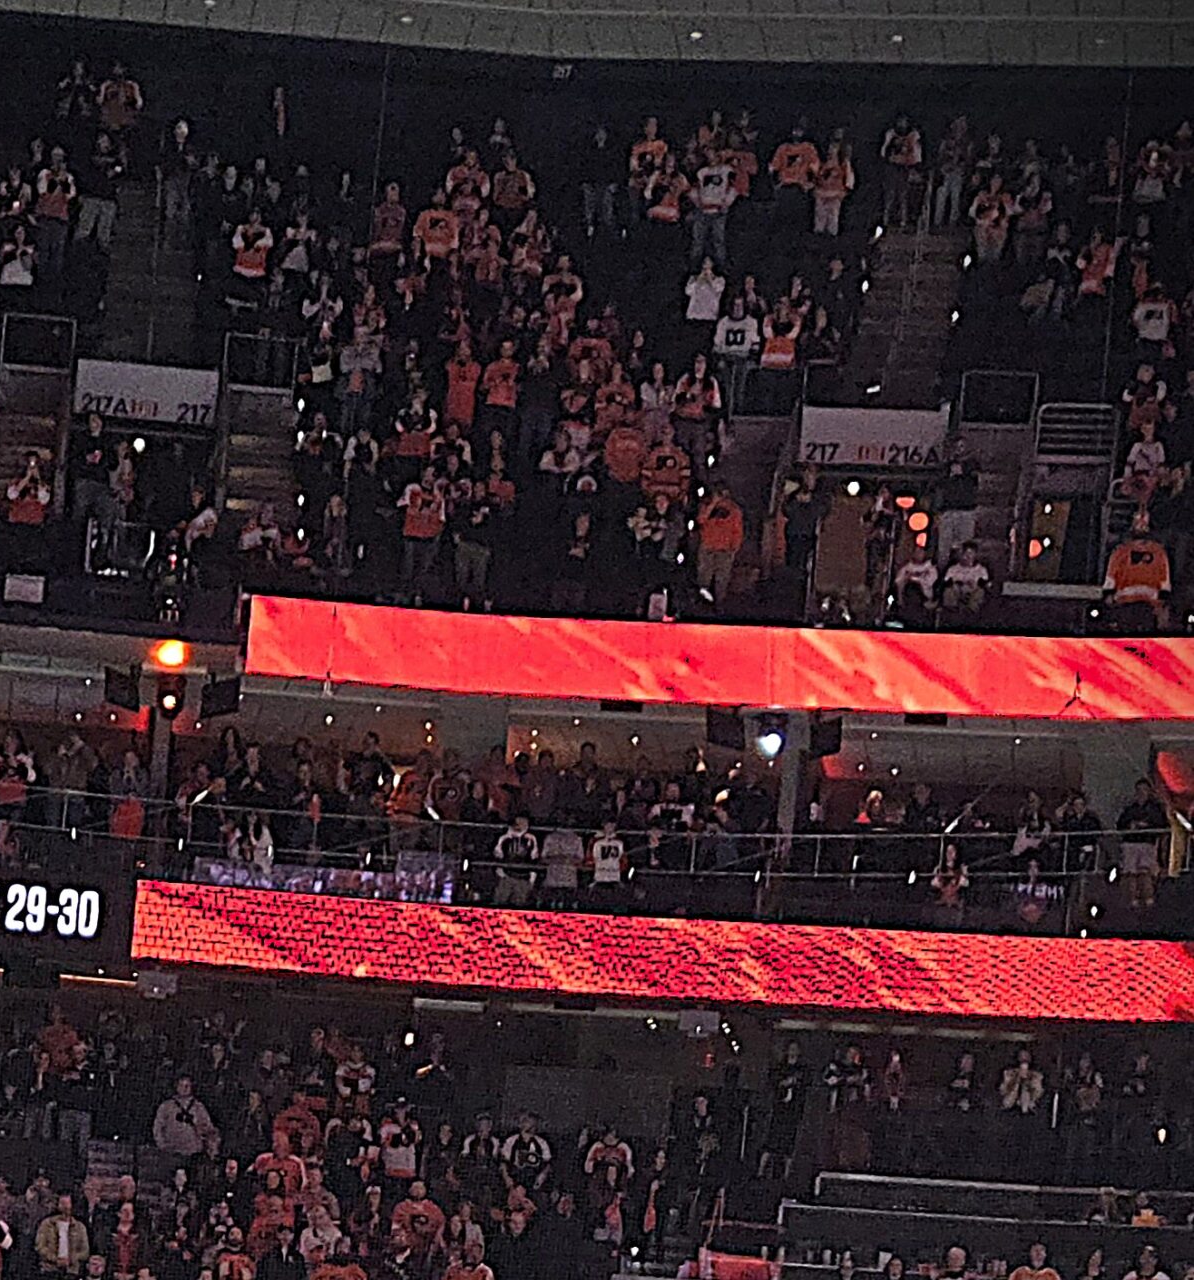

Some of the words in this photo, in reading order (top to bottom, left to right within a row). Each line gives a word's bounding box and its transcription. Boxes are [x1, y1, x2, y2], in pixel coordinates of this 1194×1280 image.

[177, 402, 212, 424] 217
[806, 442, 840, 462] 217
[4, 884, 99, 937] 29-30
